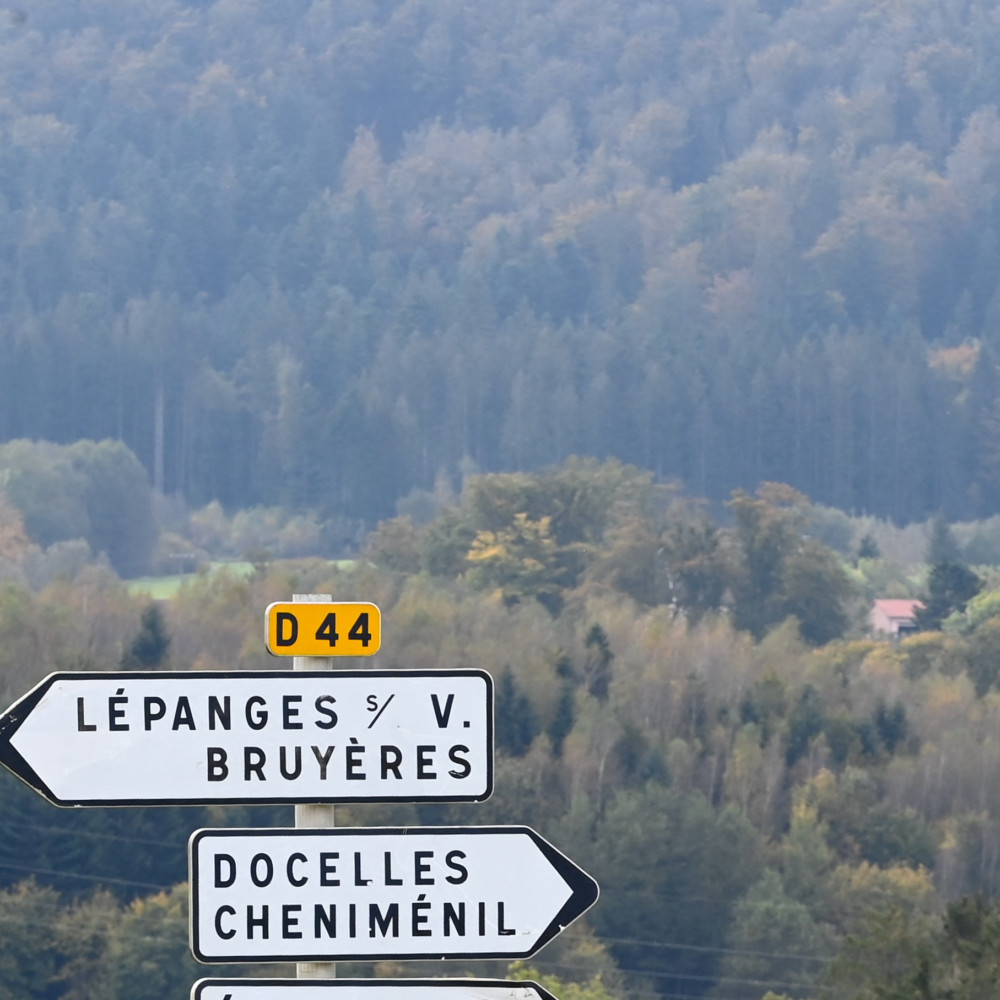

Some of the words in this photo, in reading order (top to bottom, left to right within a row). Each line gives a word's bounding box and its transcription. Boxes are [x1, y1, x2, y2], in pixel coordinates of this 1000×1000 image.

[275, 612, 299, 647] D
[315, 612, 372, 648] 44
[77, 687, 338, 732] LÉPANGES
[430, 693, 471, 729] V.
[206, 737, 472, 782] BRUYÈRES
[214, 850, 469, 889] DOCELLES
[214, 894, 516, 940] CHENIMÉNIL
